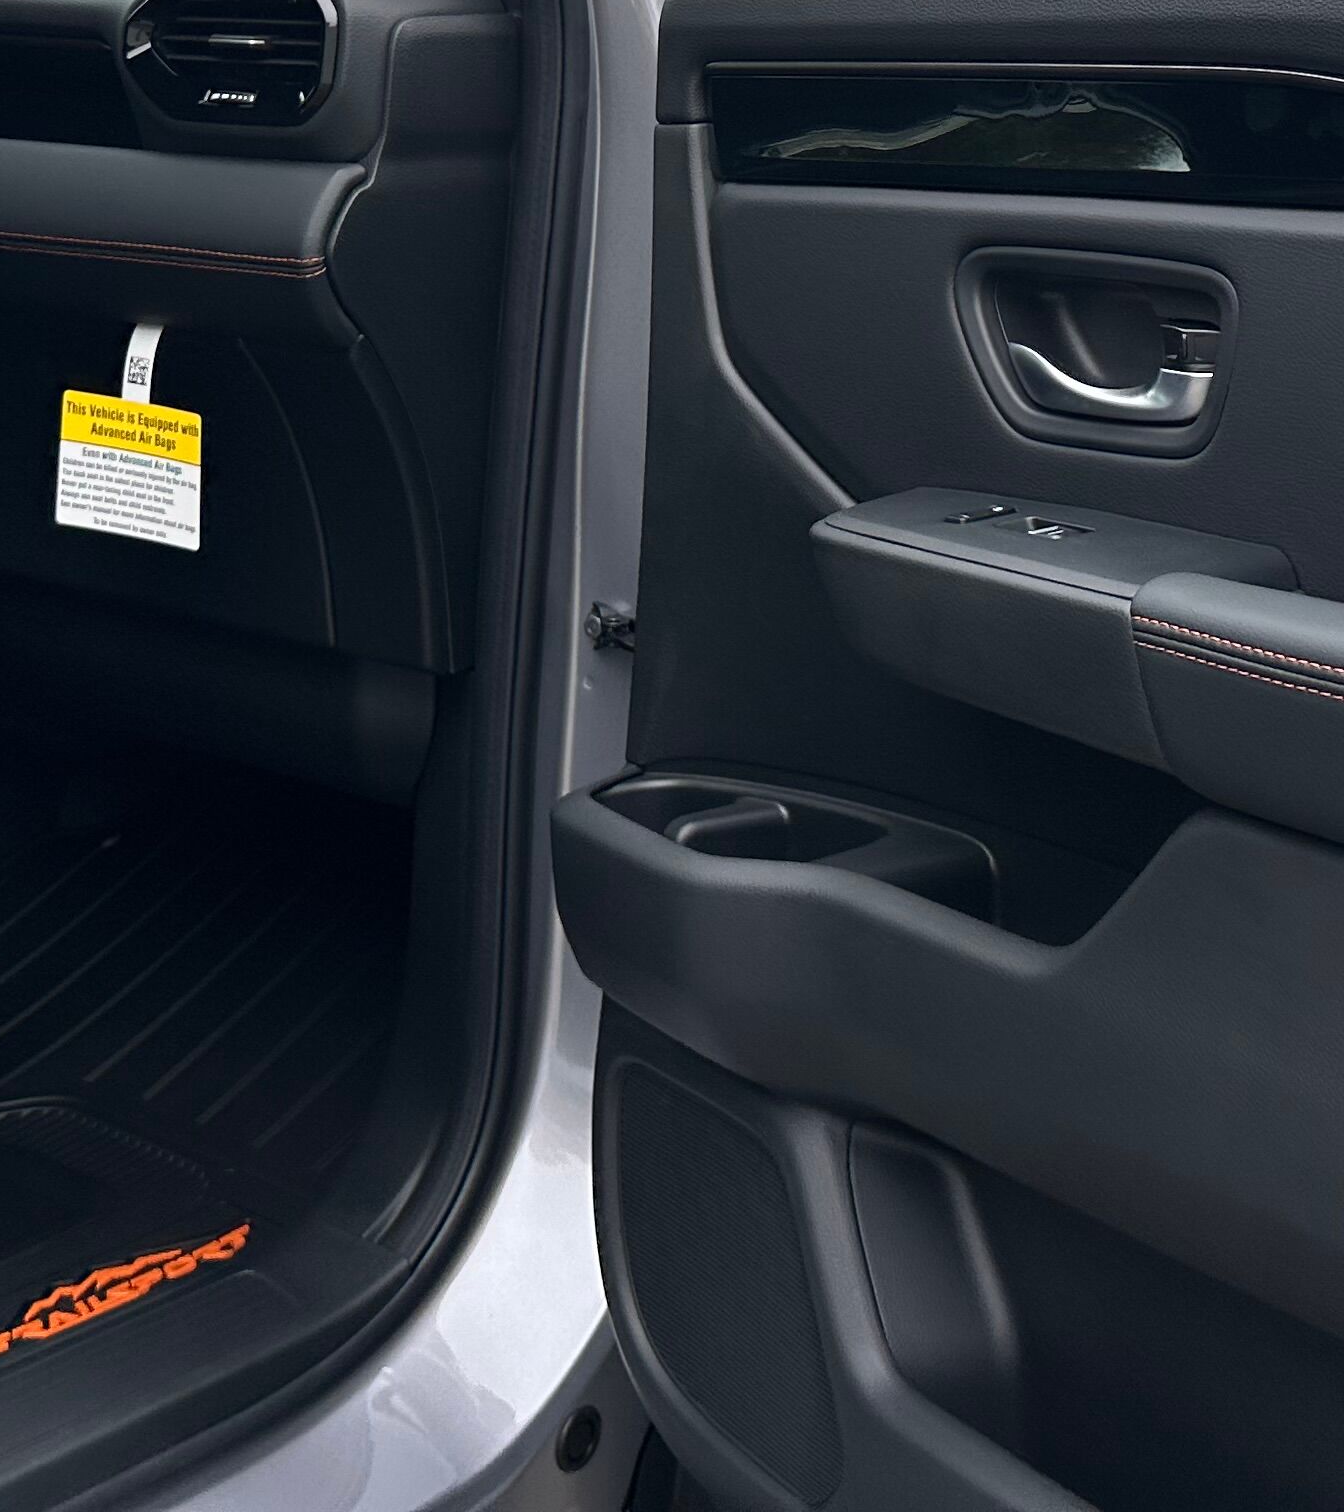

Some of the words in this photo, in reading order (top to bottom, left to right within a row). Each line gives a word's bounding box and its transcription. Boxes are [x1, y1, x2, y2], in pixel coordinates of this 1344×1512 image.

[67, 400, 86, 416] This
[90, 404, 124, 422] Vehicle
[128, 410, 135, 424] is
[138, 413, 179, 433] Equipped
[181, 423, 199, 437] with
[91, 422, 136, 442] Advanced
[139, 431, 152, 444] Air
[155, 434, 176, 451] Bags
